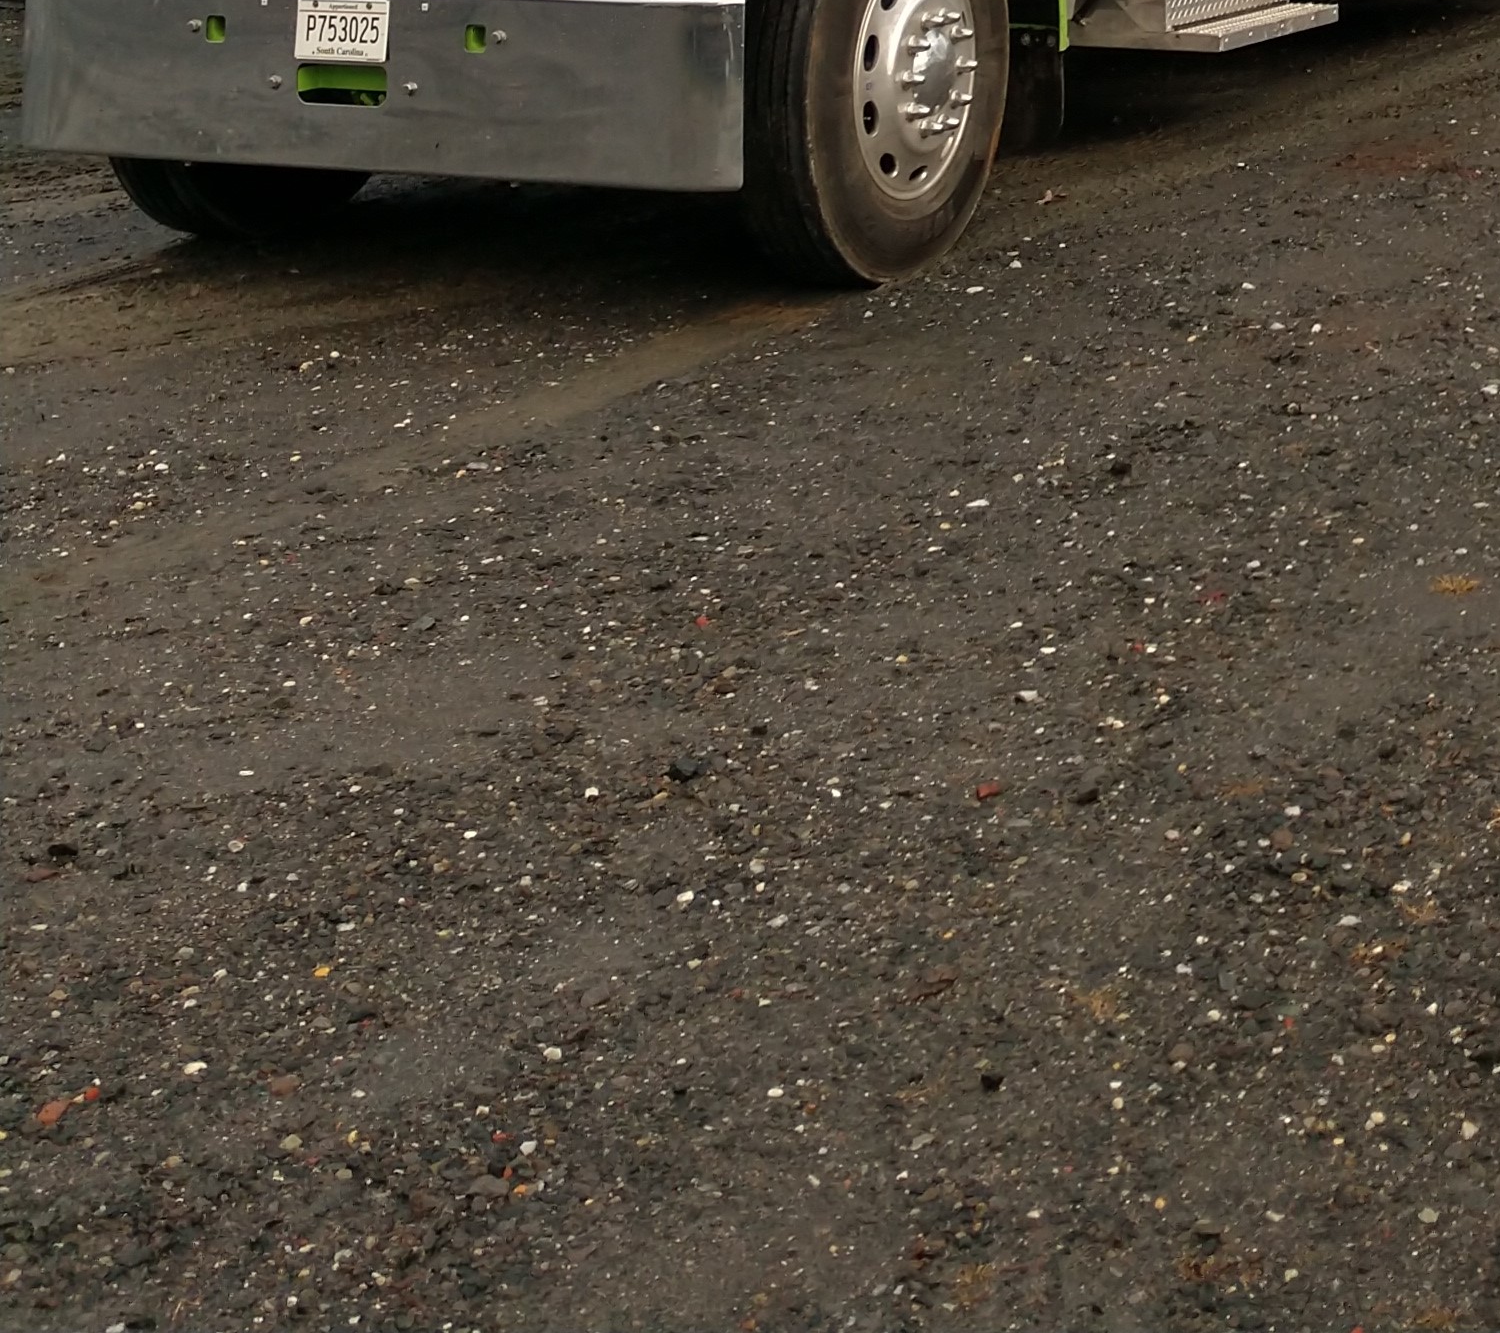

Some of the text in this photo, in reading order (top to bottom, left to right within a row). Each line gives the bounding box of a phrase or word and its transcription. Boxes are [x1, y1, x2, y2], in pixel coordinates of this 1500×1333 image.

[305, 15, 380, 44] P753025
[316, 46, 364, 57] South Carolina
